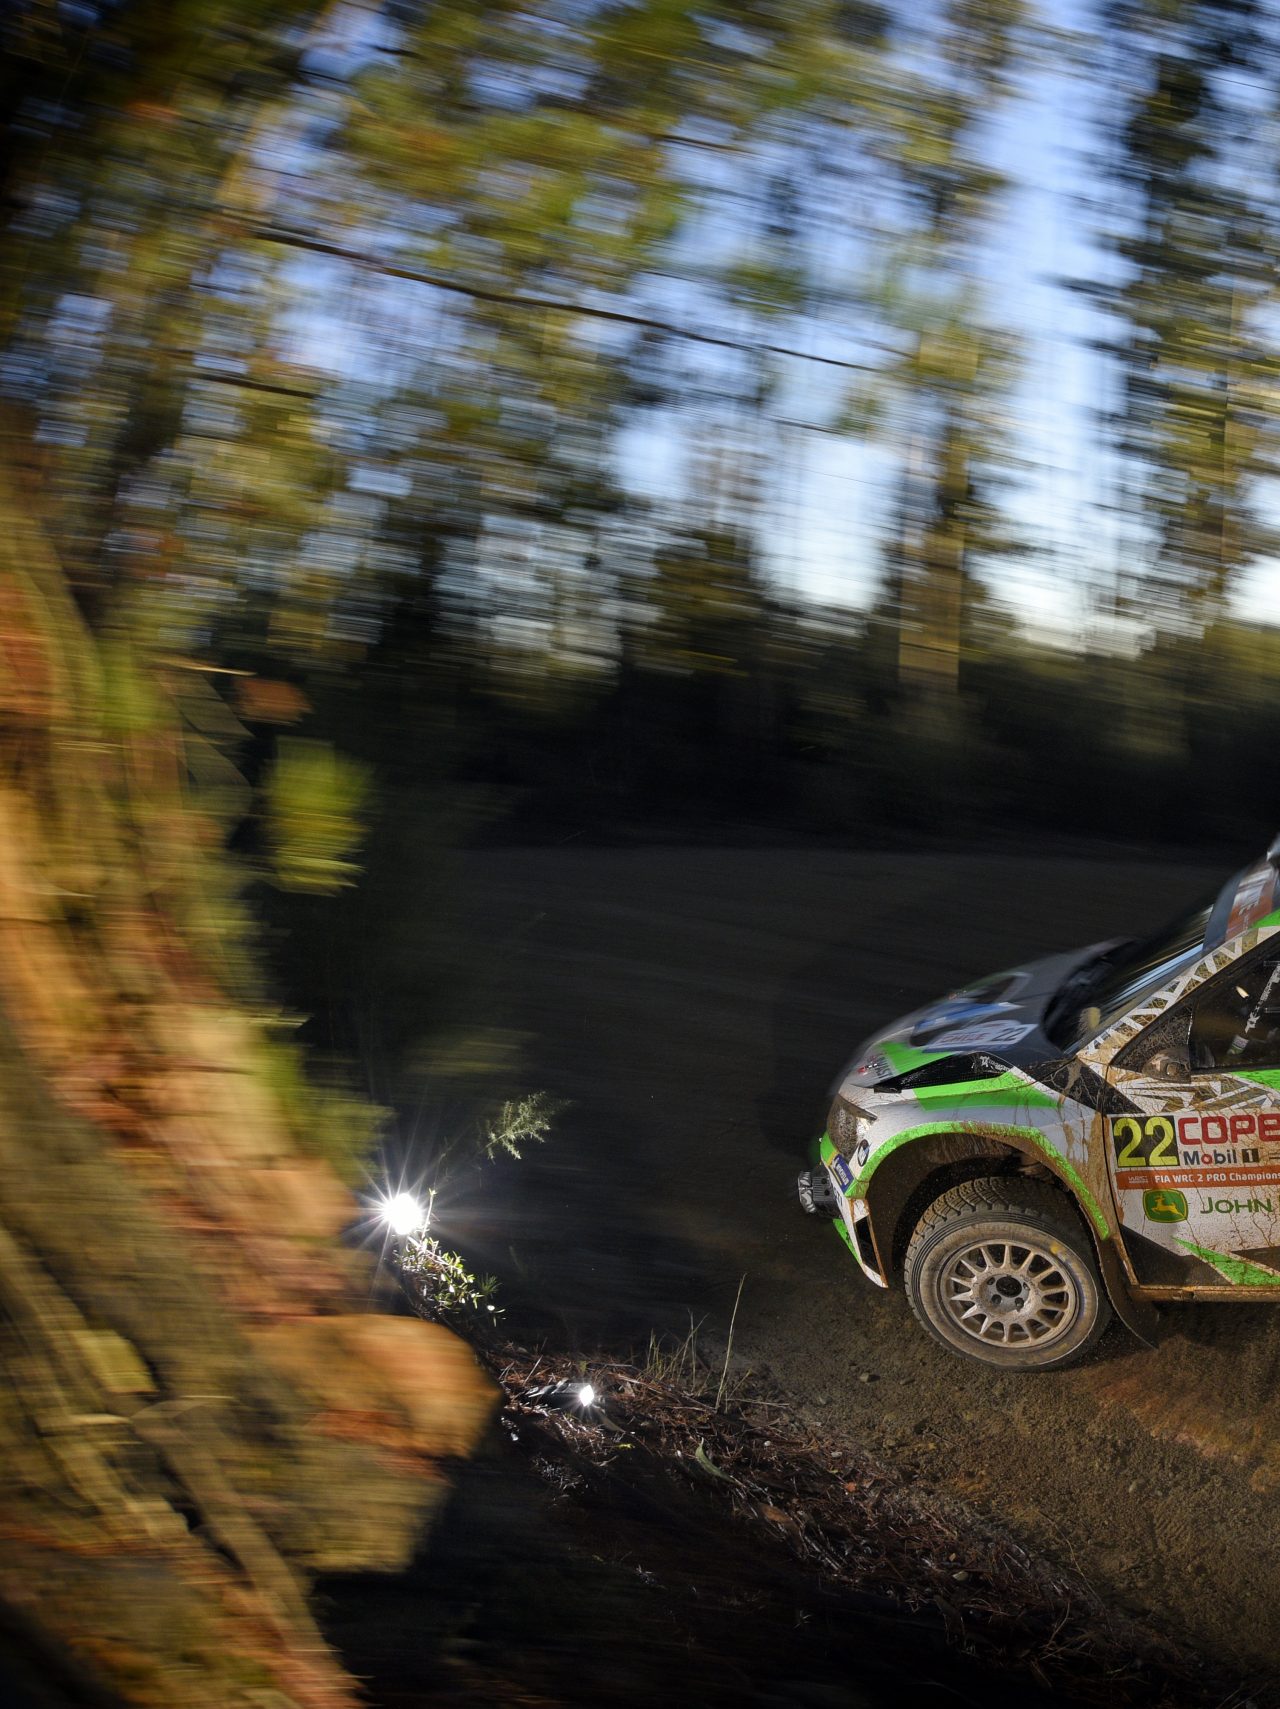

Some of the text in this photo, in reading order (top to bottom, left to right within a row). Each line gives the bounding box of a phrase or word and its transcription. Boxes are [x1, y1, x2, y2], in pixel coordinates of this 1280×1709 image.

[1113, 1116, 1178, 1168] 22
[1184, 1149, 1237, 1166] Mobil
[1154, 1174, 1172, 1184] FIA
[1172, 1174, 1194, 1183] WRC
[1196, 1174, 1204, 1183] 2
[1206, 1173, 1227, 1182] PRO
[1200, 1196, 1274, 1215] JOHN
